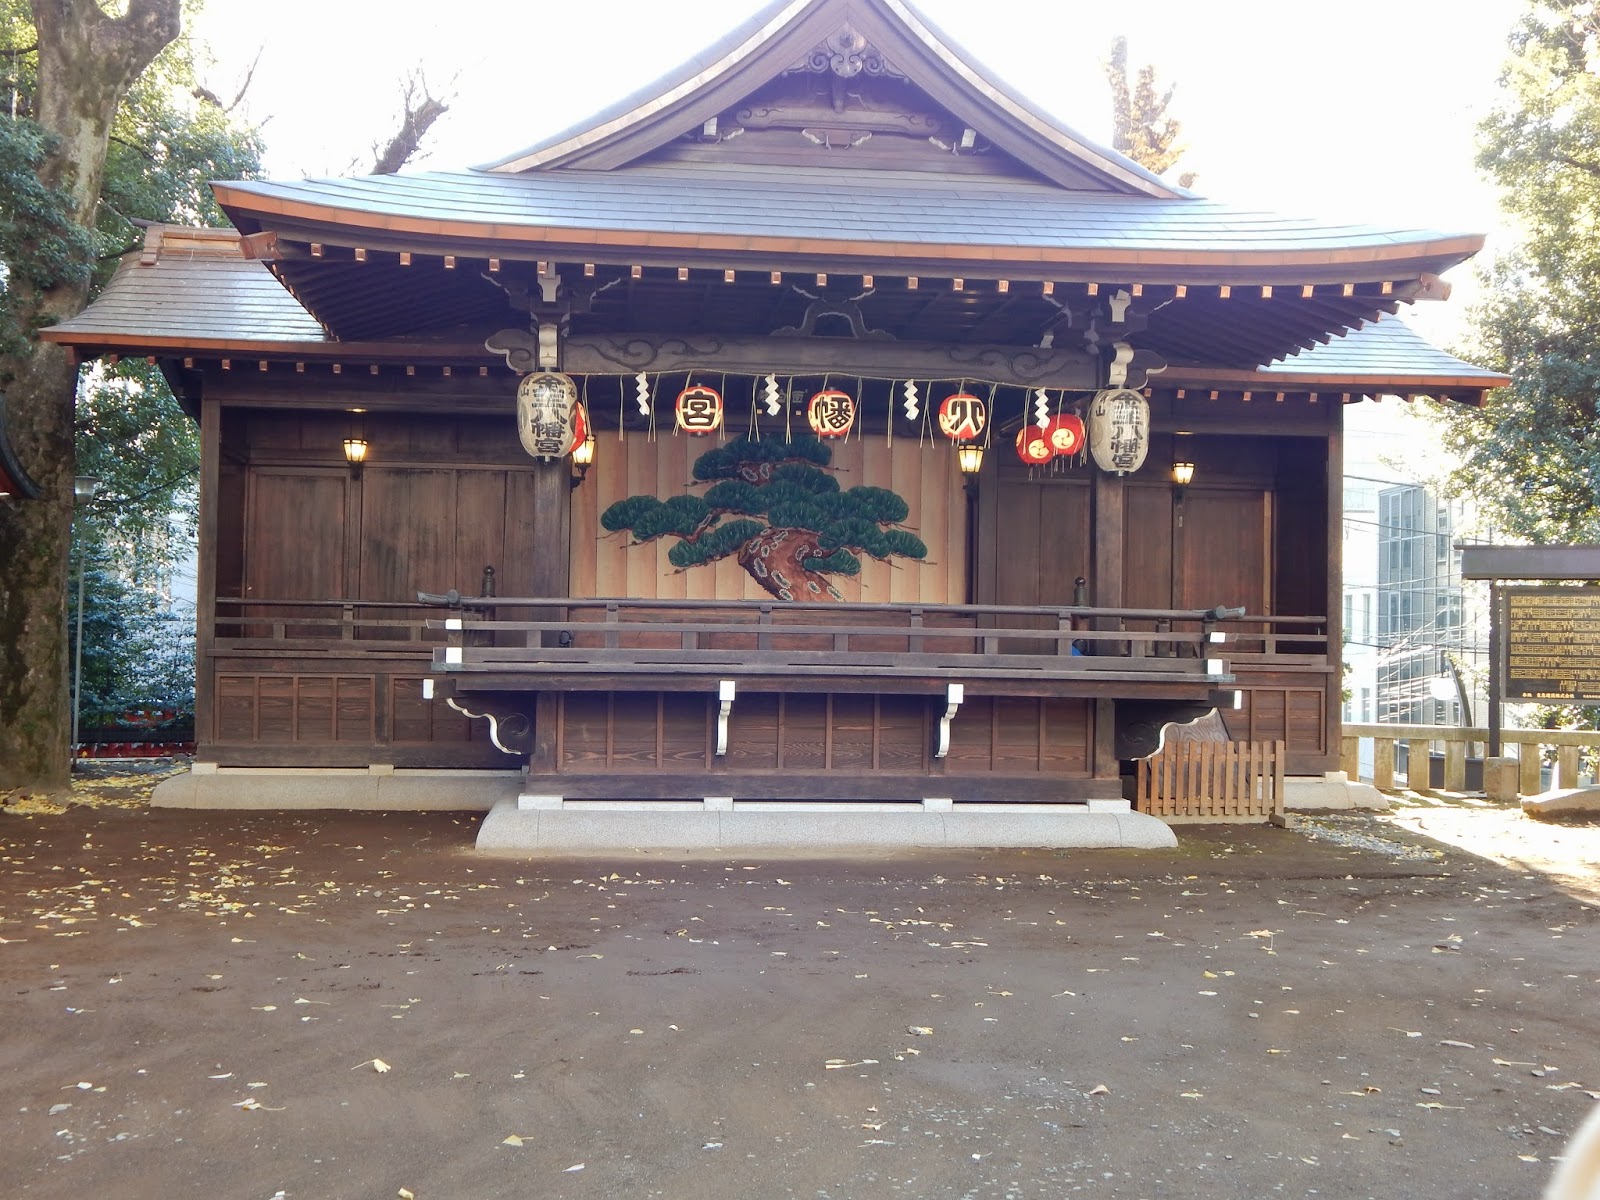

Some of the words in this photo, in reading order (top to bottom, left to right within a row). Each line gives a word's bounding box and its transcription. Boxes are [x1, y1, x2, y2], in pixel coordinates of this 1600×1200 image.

[681, 390, 717, 427] 宮
[814, 396, 852, 430] 幡
[950, 401, 983, 434] 八
